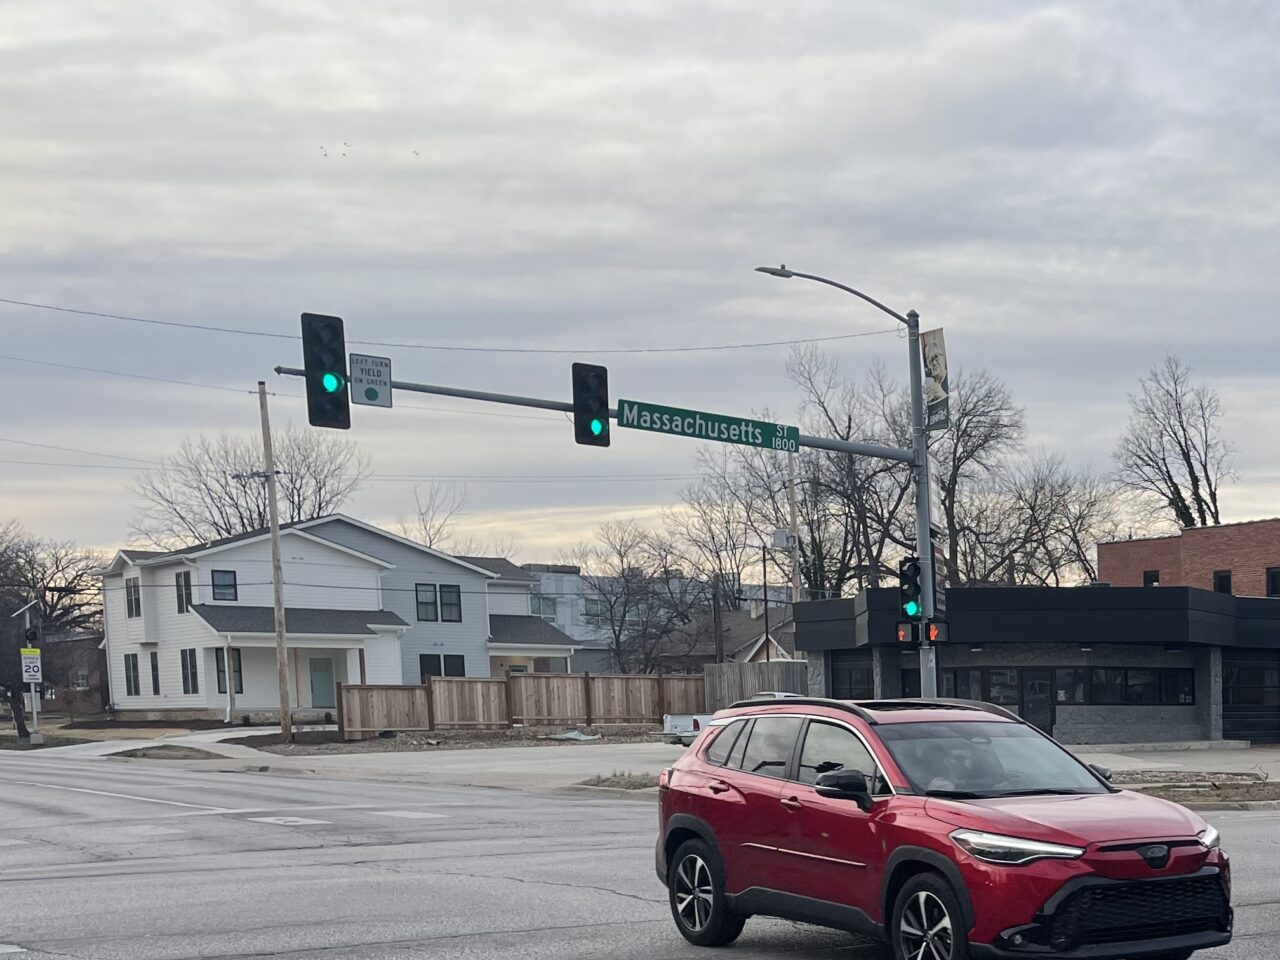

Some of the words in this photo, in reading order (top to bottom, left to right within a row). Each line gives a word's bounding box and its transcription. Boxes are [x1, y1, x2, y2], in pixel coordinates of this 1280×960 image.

[360, 367, 382, 377] YIELD
[623, 403, 762, 444] Massachusetts
[776, 424, 789, 438] ST
[772, 437, 796, 452] 1800
[24, 664, 40, 674] 20
